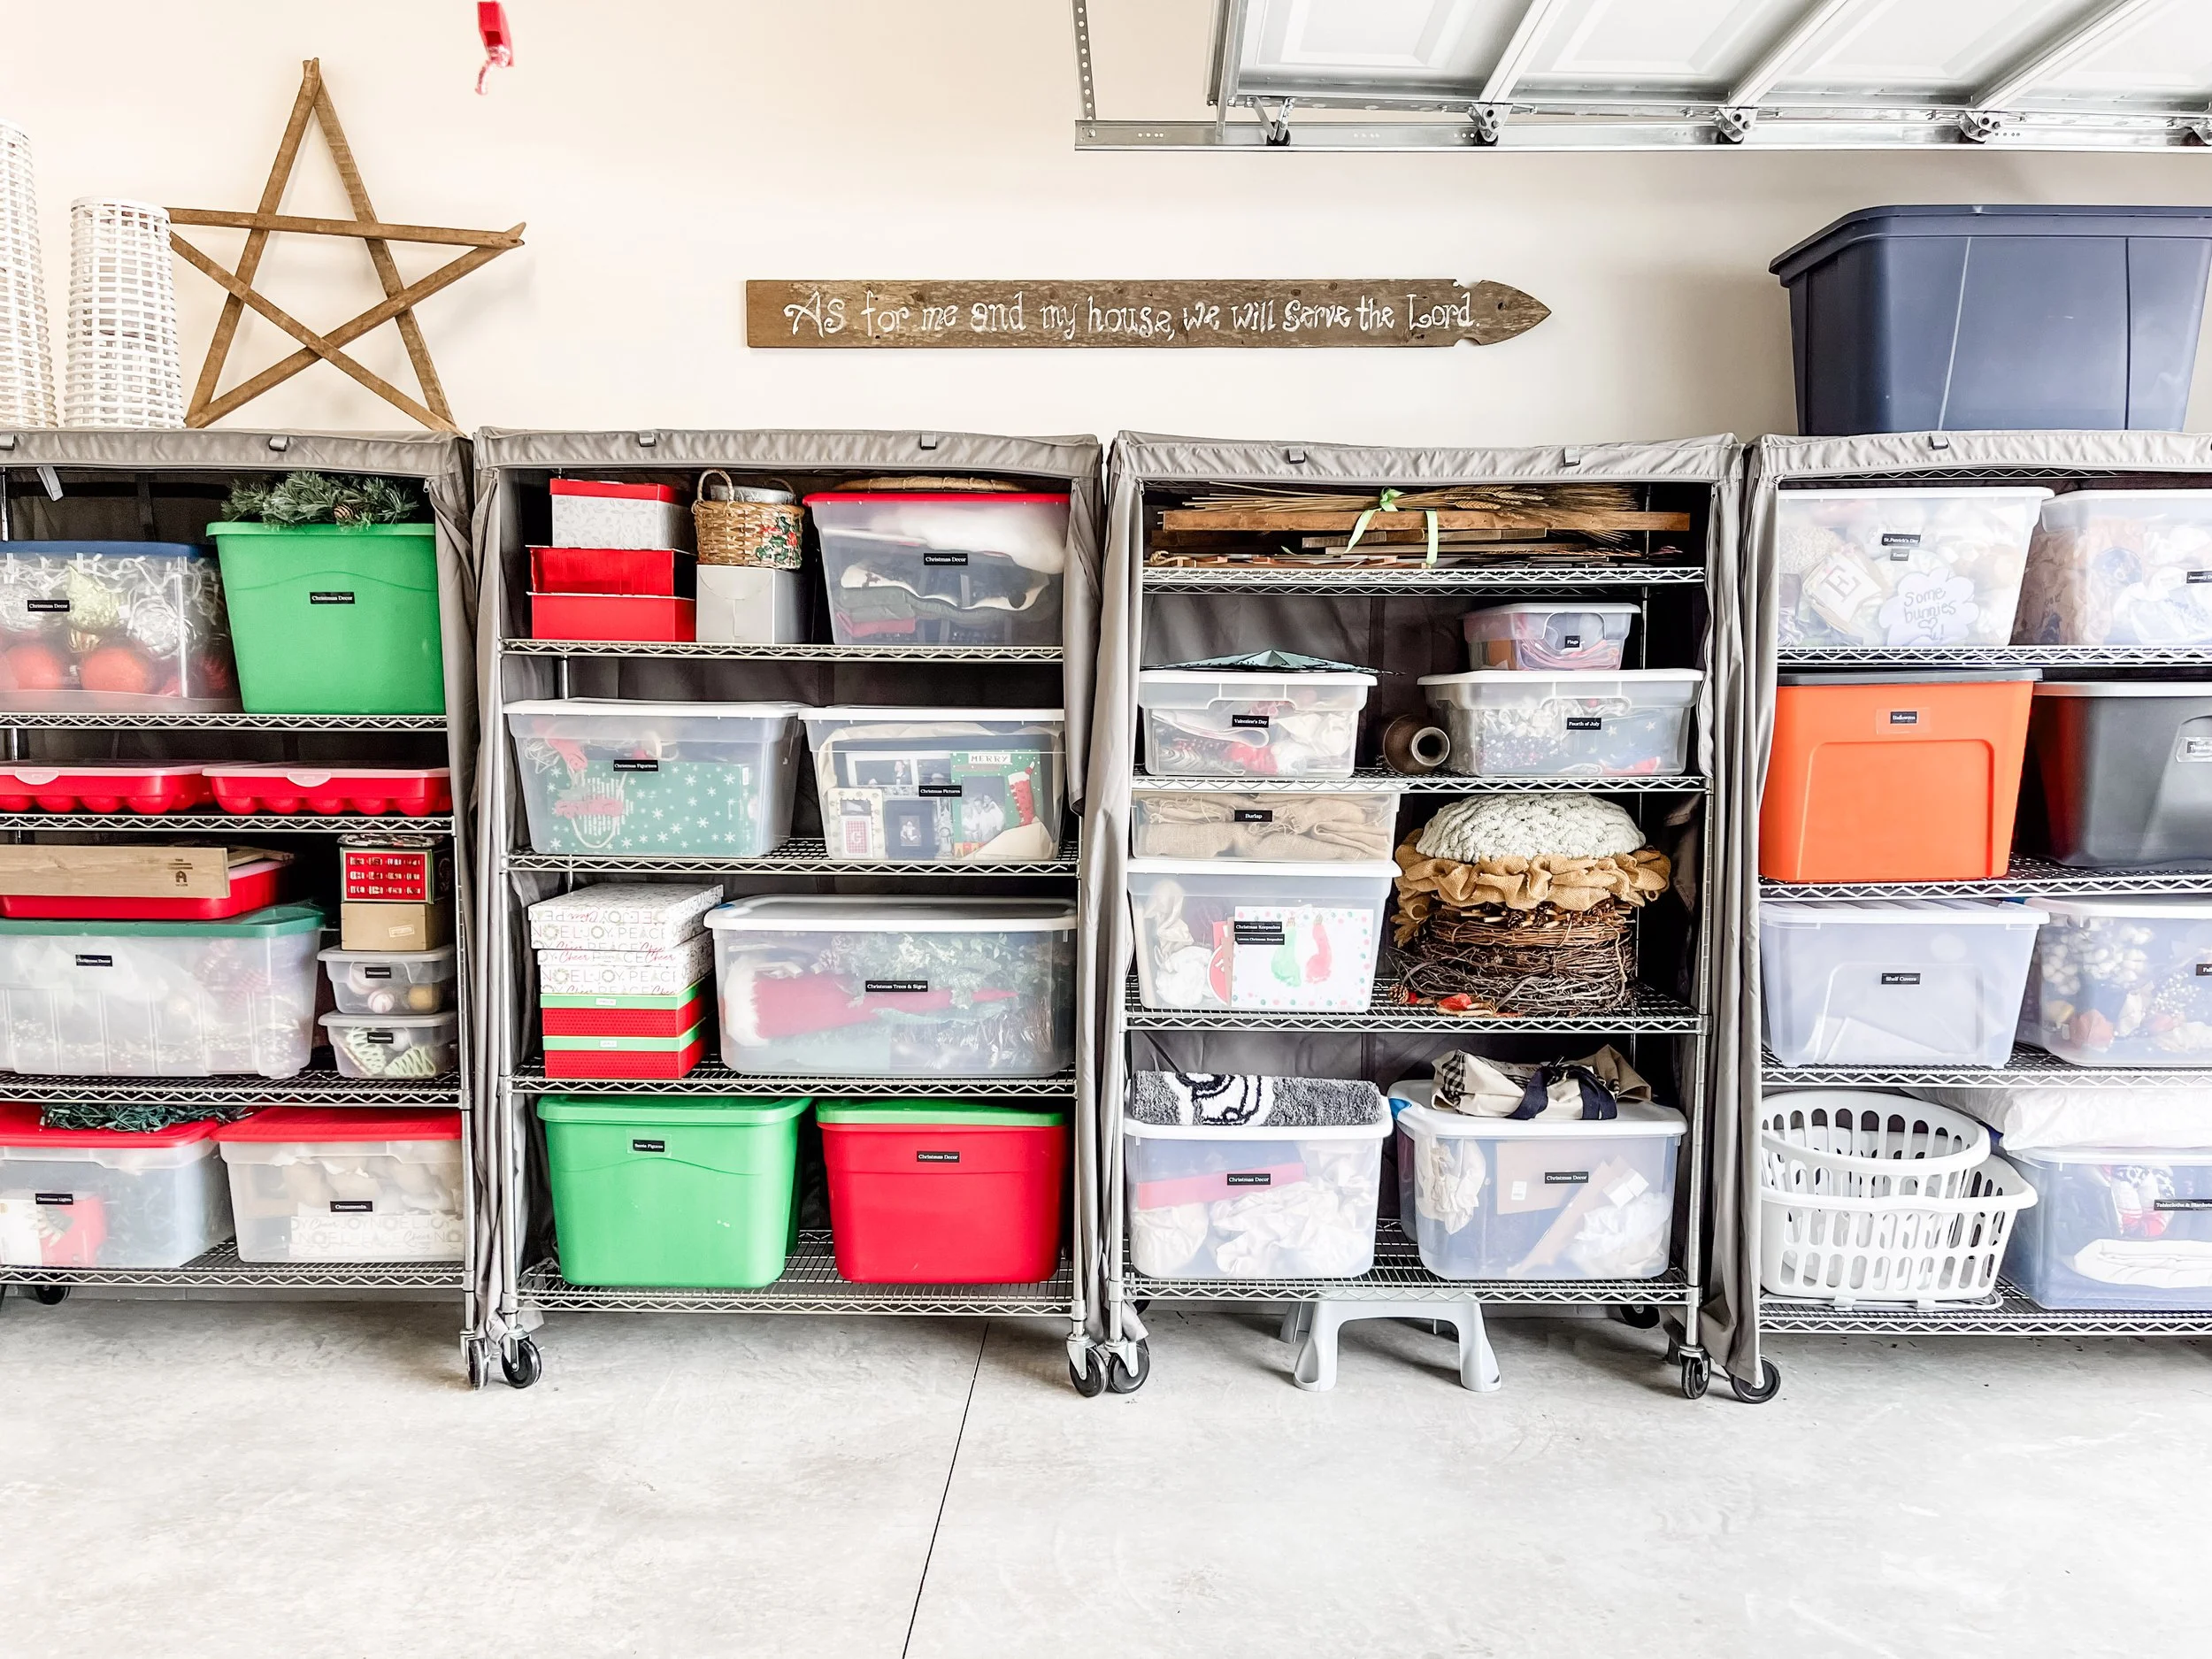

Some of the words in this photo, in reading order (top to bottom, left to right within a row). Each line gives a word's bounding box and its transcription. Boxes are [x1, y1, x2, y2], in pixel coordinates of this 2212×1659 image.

[783, 290, 846, 338] As
[860, 289, 910, 337] for
[920, 304, 959, 331] me
[970, 290, 1027, 334] and
[1040, 302, 1078, 340] my
[1182, 300, 1221, 331] we
[1230, 299, 1277, 333] will
[1355, 295, 1395, 332] the
[1405, 291, 1480, 331] Lord.
[1903, 587, 1947, 607] Some
[1904, 600, 1957, 623] bunnies
